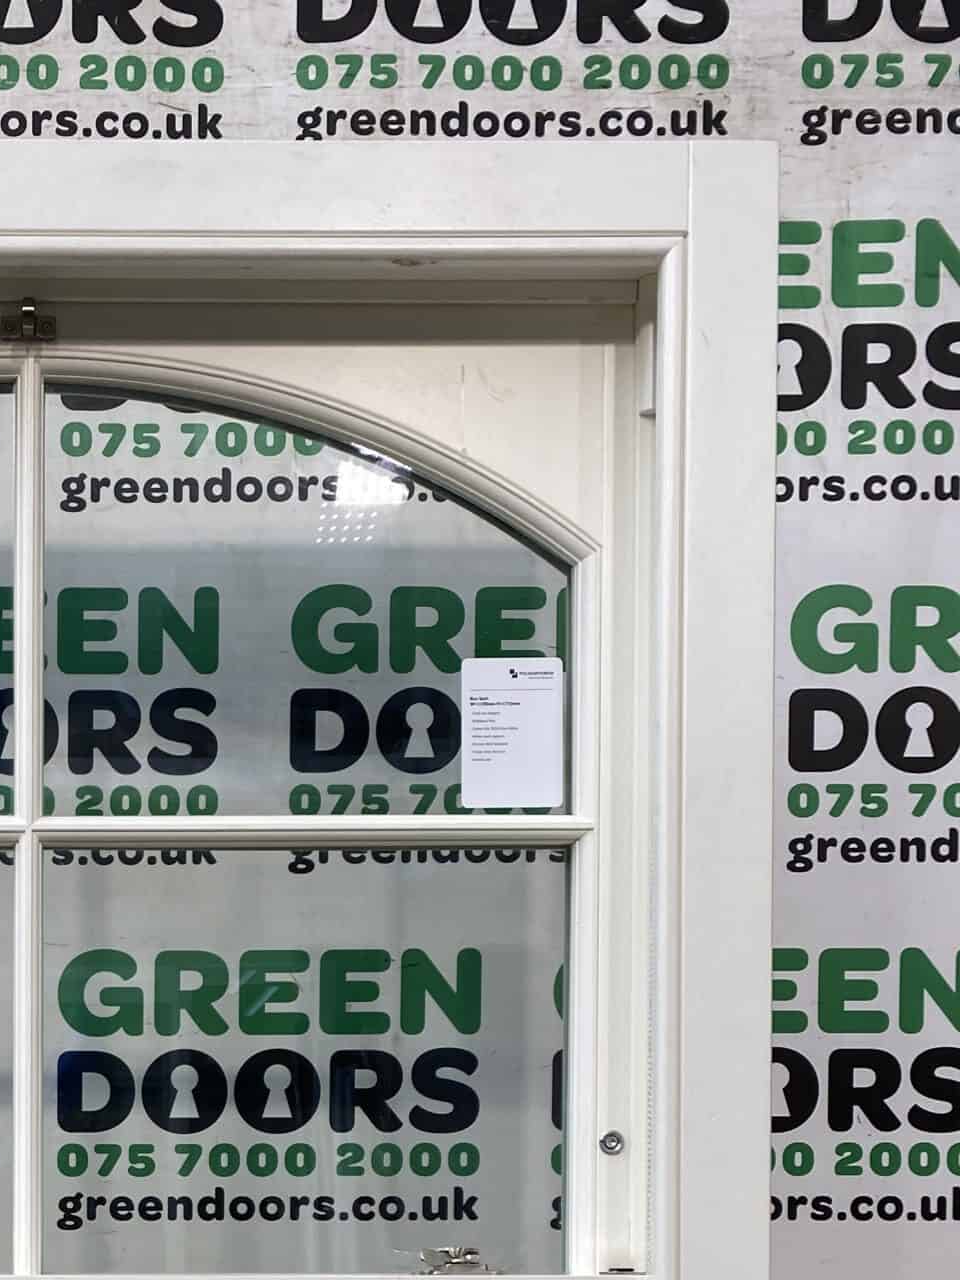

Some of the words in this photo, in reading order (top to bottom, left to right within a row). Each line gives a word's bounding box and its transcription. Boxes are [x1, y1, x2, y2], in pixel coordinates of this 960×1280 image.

[79, 55, 224, 93] 2000
[296, 54, 398, 90] 075
[418, 54, 562, 90] 7000
[583, 54, 730, 90] 2000
[801, 53, 905, 88] 075
[296, 100, 728, 140] greendoors.co.uk
[60, 422, 161, 457] 075
[291, 584, 567, 675] GRE
[76, 785, 218, 816] 2000
[289, 784, 390, 815] 075
[787, 783, 888, 818] 075
[57, 948, 482, 1037] GREEN
[57, 1048, 480, 1134] DOORS
[57, 1143, 156, 1177] 075
[175, 1143, 317, 1177] 7000
[336, 1143, 480, 1177] 2000
[56, 1187, 480, 1230] greendoors.co.uk
